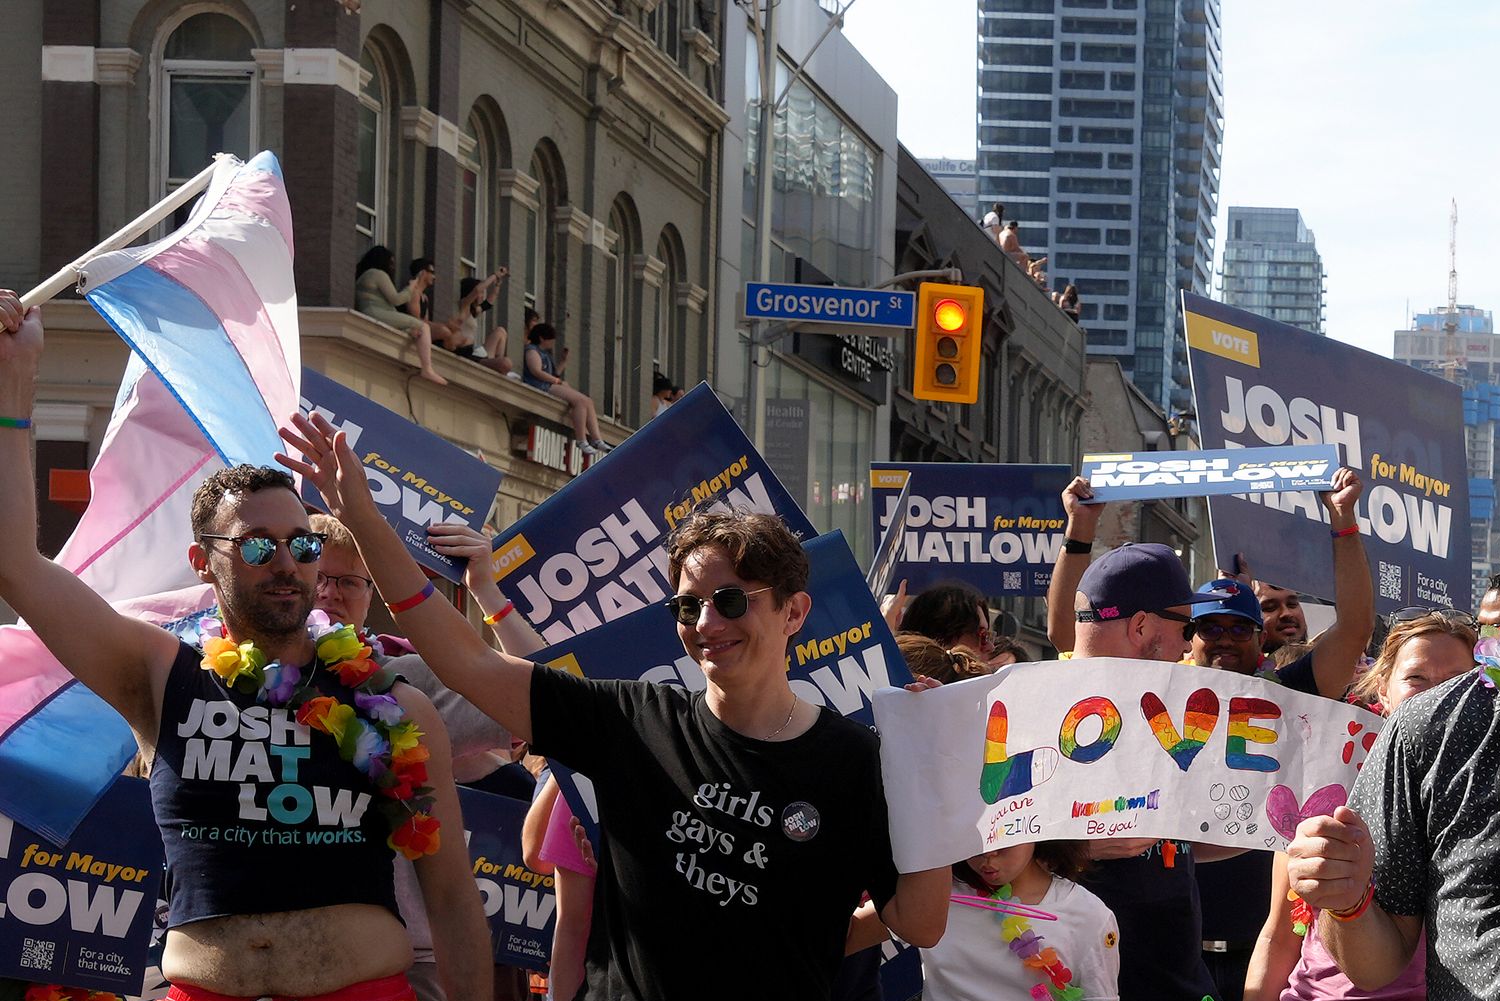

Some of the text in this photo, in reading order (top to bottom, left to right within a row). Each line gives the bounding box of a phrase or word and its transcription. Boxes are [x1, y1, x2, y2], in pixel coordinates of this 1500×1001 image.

[756, 288, 902, 318] Grosvenor St
[857, 335, 894, 373] WELLNESS
[1212, 330, 1249, 355] VOTE
[842, 346, 871, 383] CENTRE
[766, 405, 805, 418] Health
[1220, 375, 1363, 470] JOSH
[532, 425, 568, 472] HOME
[878, 475, 904, 483] VOTE
[1090, 463, 1329, 488] MATLOW
[1092, 458, 1229, 474] JOSH
[1371, 453, 1451, 498] for Mayor
[362, 466, 470, 528] OW
[363, 452, 475, 515] for Mayor
[663, 499, 693, 530] for
[691, 454, 749, 505] Mayor
[879, 495, 986, 528] JOSH
[993, 515, 1064, 532] for Mayor
[405, 536, 425, 551] that
[425, 547, 453, 566] works.
[408, 529, 422, 541] For
[491, 544, 523, 574] VOTE
[516, 498, 661, 625] JOSH
[1417, 572, 1448, 595] For a city
[1417, 586, 1431, 600] that
[795, 621, 872, 666] Mayor
[177, 698, 311, 746] JOSH
[181, 738, 311, 783] MAT
[979, 687, 1282, 806] LOVE
[238, 783, 372, 829] LOW
[693, 782, 774, 827] girls
[784, 811, 804, 826] JOSH
[990, 797, 1035, 831] you are
[181, 823, 367, 847] For a city that works.
[665, 810, 735, 855] gays
[1087, 814, 1138, 836] Be you!
[20, 844, 149, 883] for Mayor
[743, 842, 769, 869] &
[473, 856, 555, 889] for Mayo
[675, 852, 759, 906] theys
[0, 872, 145, 939] OW
[79, 947, 124, 965] For a city
[507, 942, 522, 952] that
[509, 934, 523, 944] For
[528, 939, 541, 949] city
[78, 959, 132, 976] that works.
